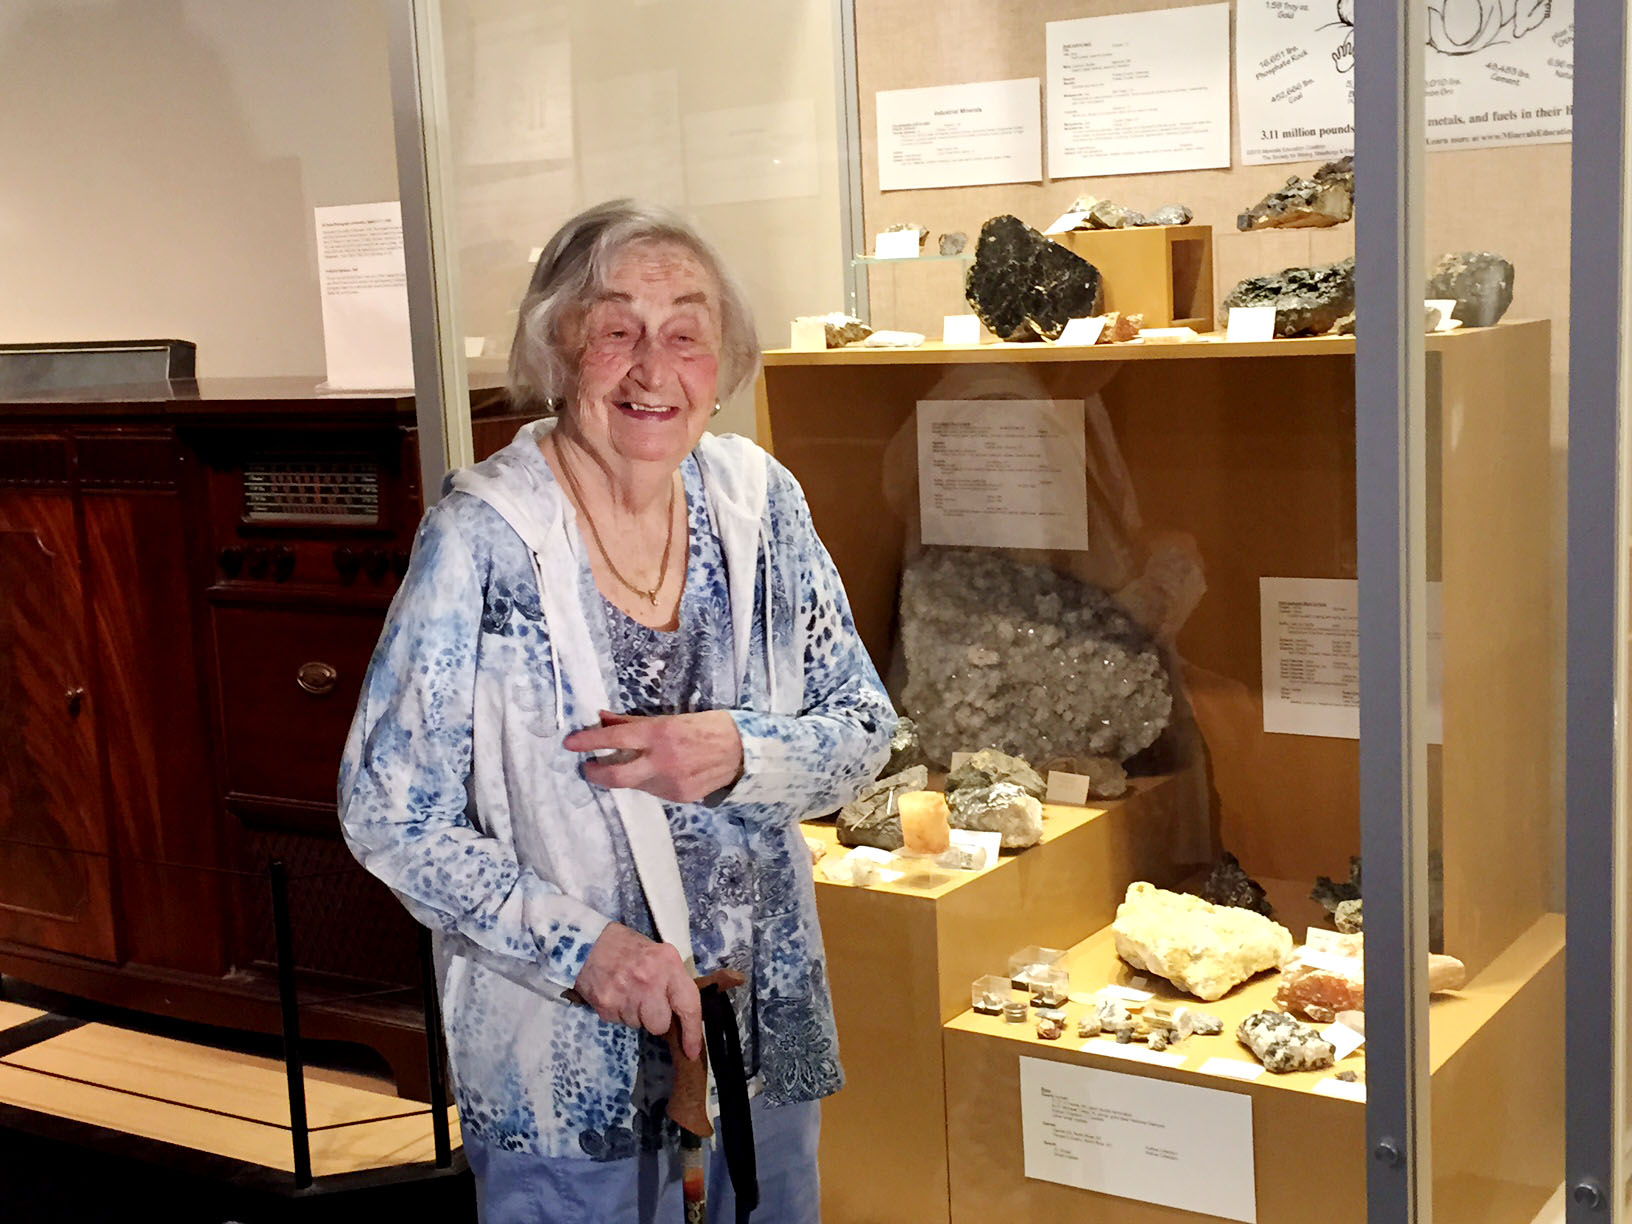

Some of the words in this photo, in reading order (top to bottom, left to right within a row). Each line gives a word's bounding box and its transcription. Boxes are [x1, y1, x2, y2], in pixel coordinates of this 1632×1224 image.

[1278, 10, 1294, 19] Gold
[1255, 59, 1291, 80] Phosphate
[1291, 49, 1308, 61] Rock
[1490, 72, 1520, 86] Cement
[1288, 92, 1303, 104] Coal
[1469, 112, 1488, 123] and
[1493, 110, 1517, 121] fuels
[1521, 108, 1532, 119] in
[1536, 106, 1562, 118] their
[1260, 130, 1278, 140] 3.11
[1282, 126, 1316, 139] million
